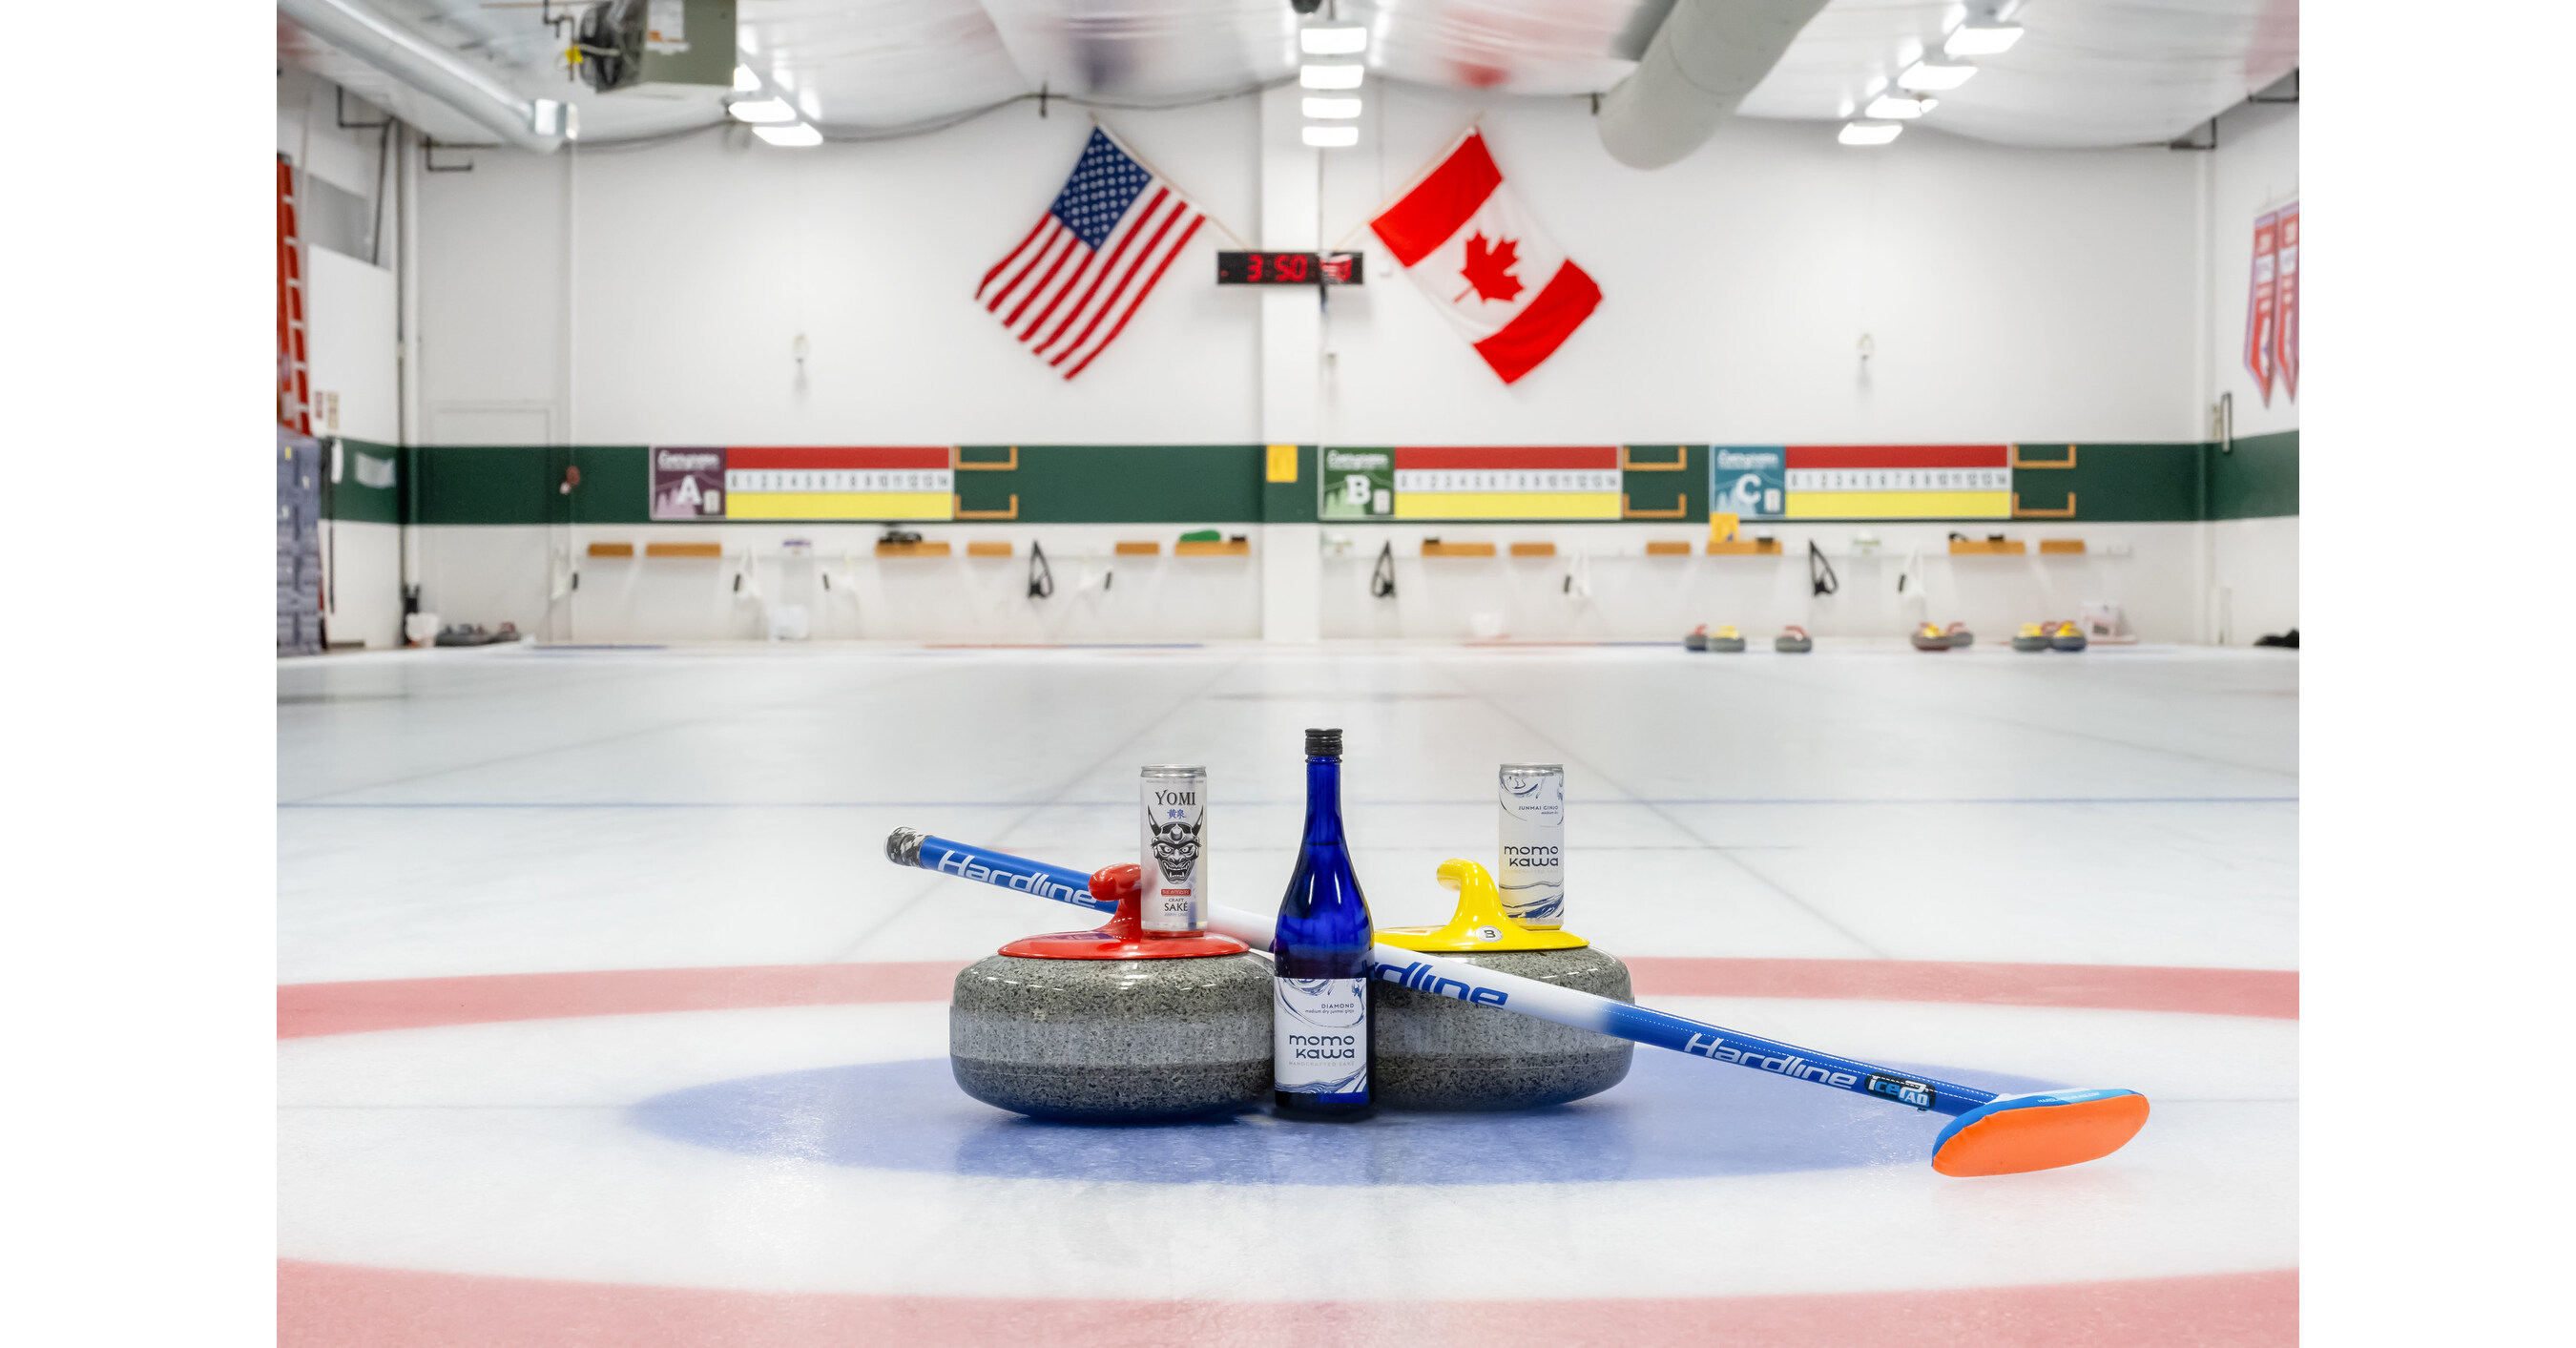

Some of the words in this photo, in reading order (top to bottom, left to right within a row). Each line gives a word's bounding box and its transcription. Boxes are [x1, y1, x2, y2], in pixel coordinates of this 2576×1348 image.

[676, 474, 703, 506] A
[1345, 474, 1371, 505] B
[1735, 473, 1762, 505] C
[1154, 789, 1196, 806] YOMI
[1167, 808, 1187, 819] 黄泉
[1504, 845, 1559, 855] momo
[1509, 858, 1559, 867] kawa
[937, 850, 1098, 908] Hardline
[1164, 902, 1188, 912] SAKÉ
[1484, 929, 1496, 938] 3
[1375, 961, 1509, 1010] dline
[1289, 1034, 1355, 1046] momo
[1296, 1047, 1355, 1059] kawa
[1683, 1032, 1858, 1089] Hardline
